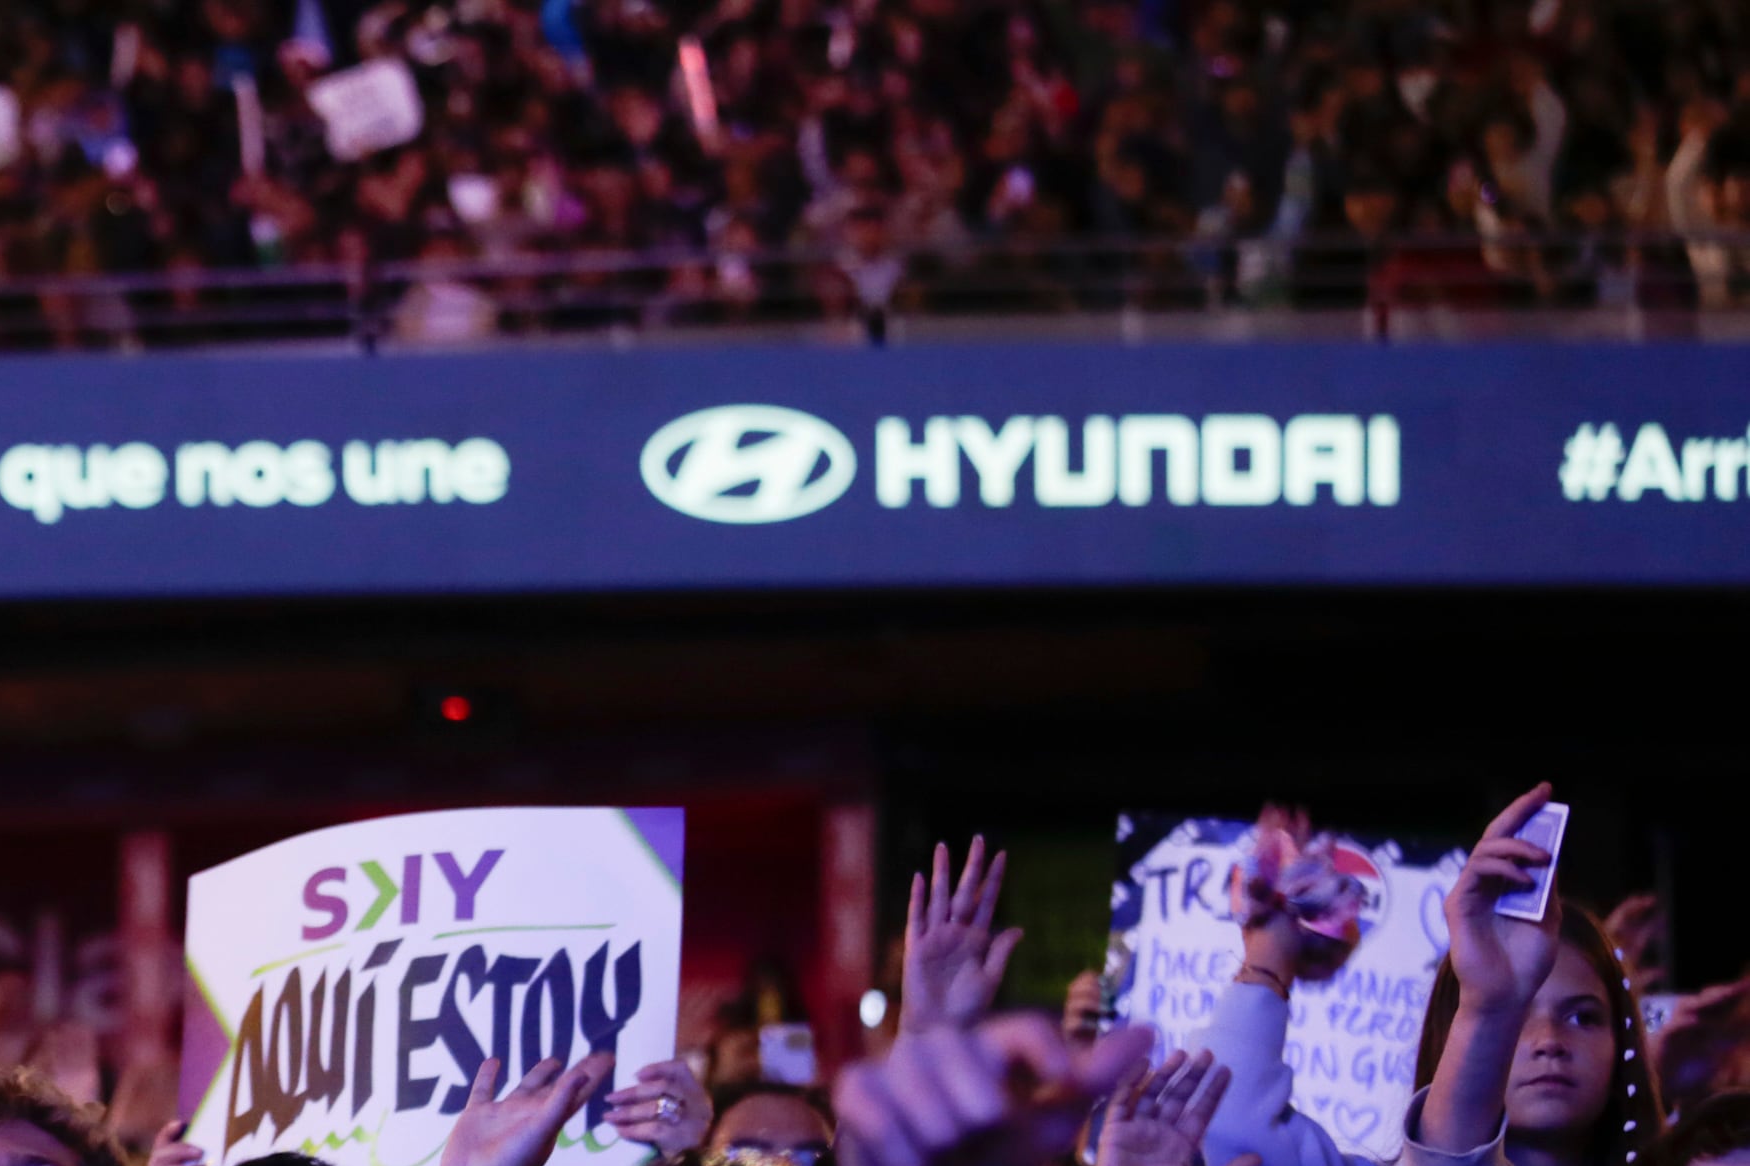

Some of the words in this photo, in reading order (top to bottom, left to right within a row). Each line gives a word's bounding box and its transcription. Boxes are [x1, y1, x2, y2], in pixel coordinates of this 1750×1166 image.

[174, 438, 337, 508] nos
[341, 436, 511, 506] une
[873, 412, 1401, 509] HYUNDAI
[1557, 421, 1750, 502] #Arr
[394, 939, 642, 1132] ESTOY
